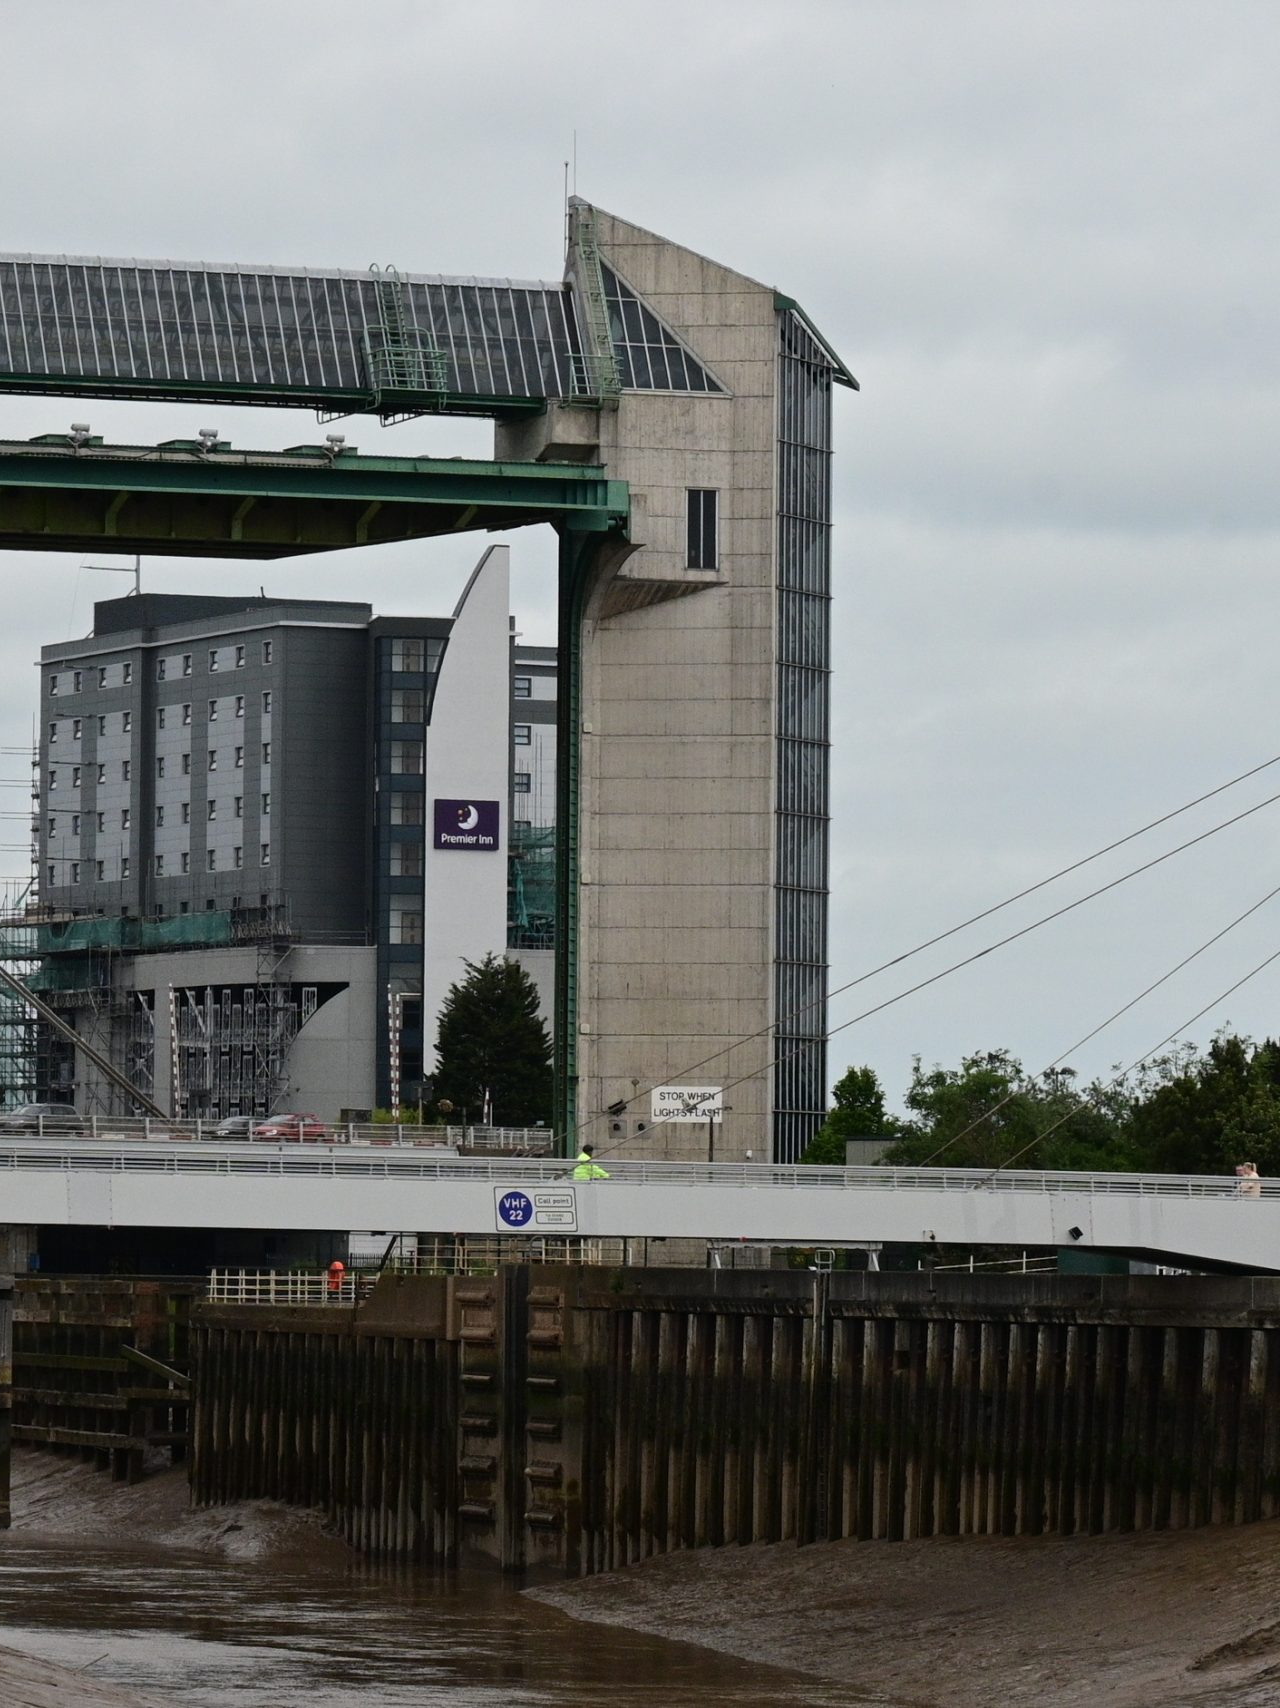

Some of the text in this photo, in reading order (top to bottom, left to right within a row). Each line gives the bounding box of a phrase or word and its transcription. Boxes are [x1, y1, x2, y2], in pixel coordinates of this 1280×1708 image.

[441, 833, 493, 845] Premier Inn
[659, 1092, 715, 1101] STOP WHEN
[654, 1108, 687, 1117] LIGHTS
[503, 1198, 527, 1209] VHF
[552, 1197, 570, 1205] point
[509, 1210, 523, 1220] 22
